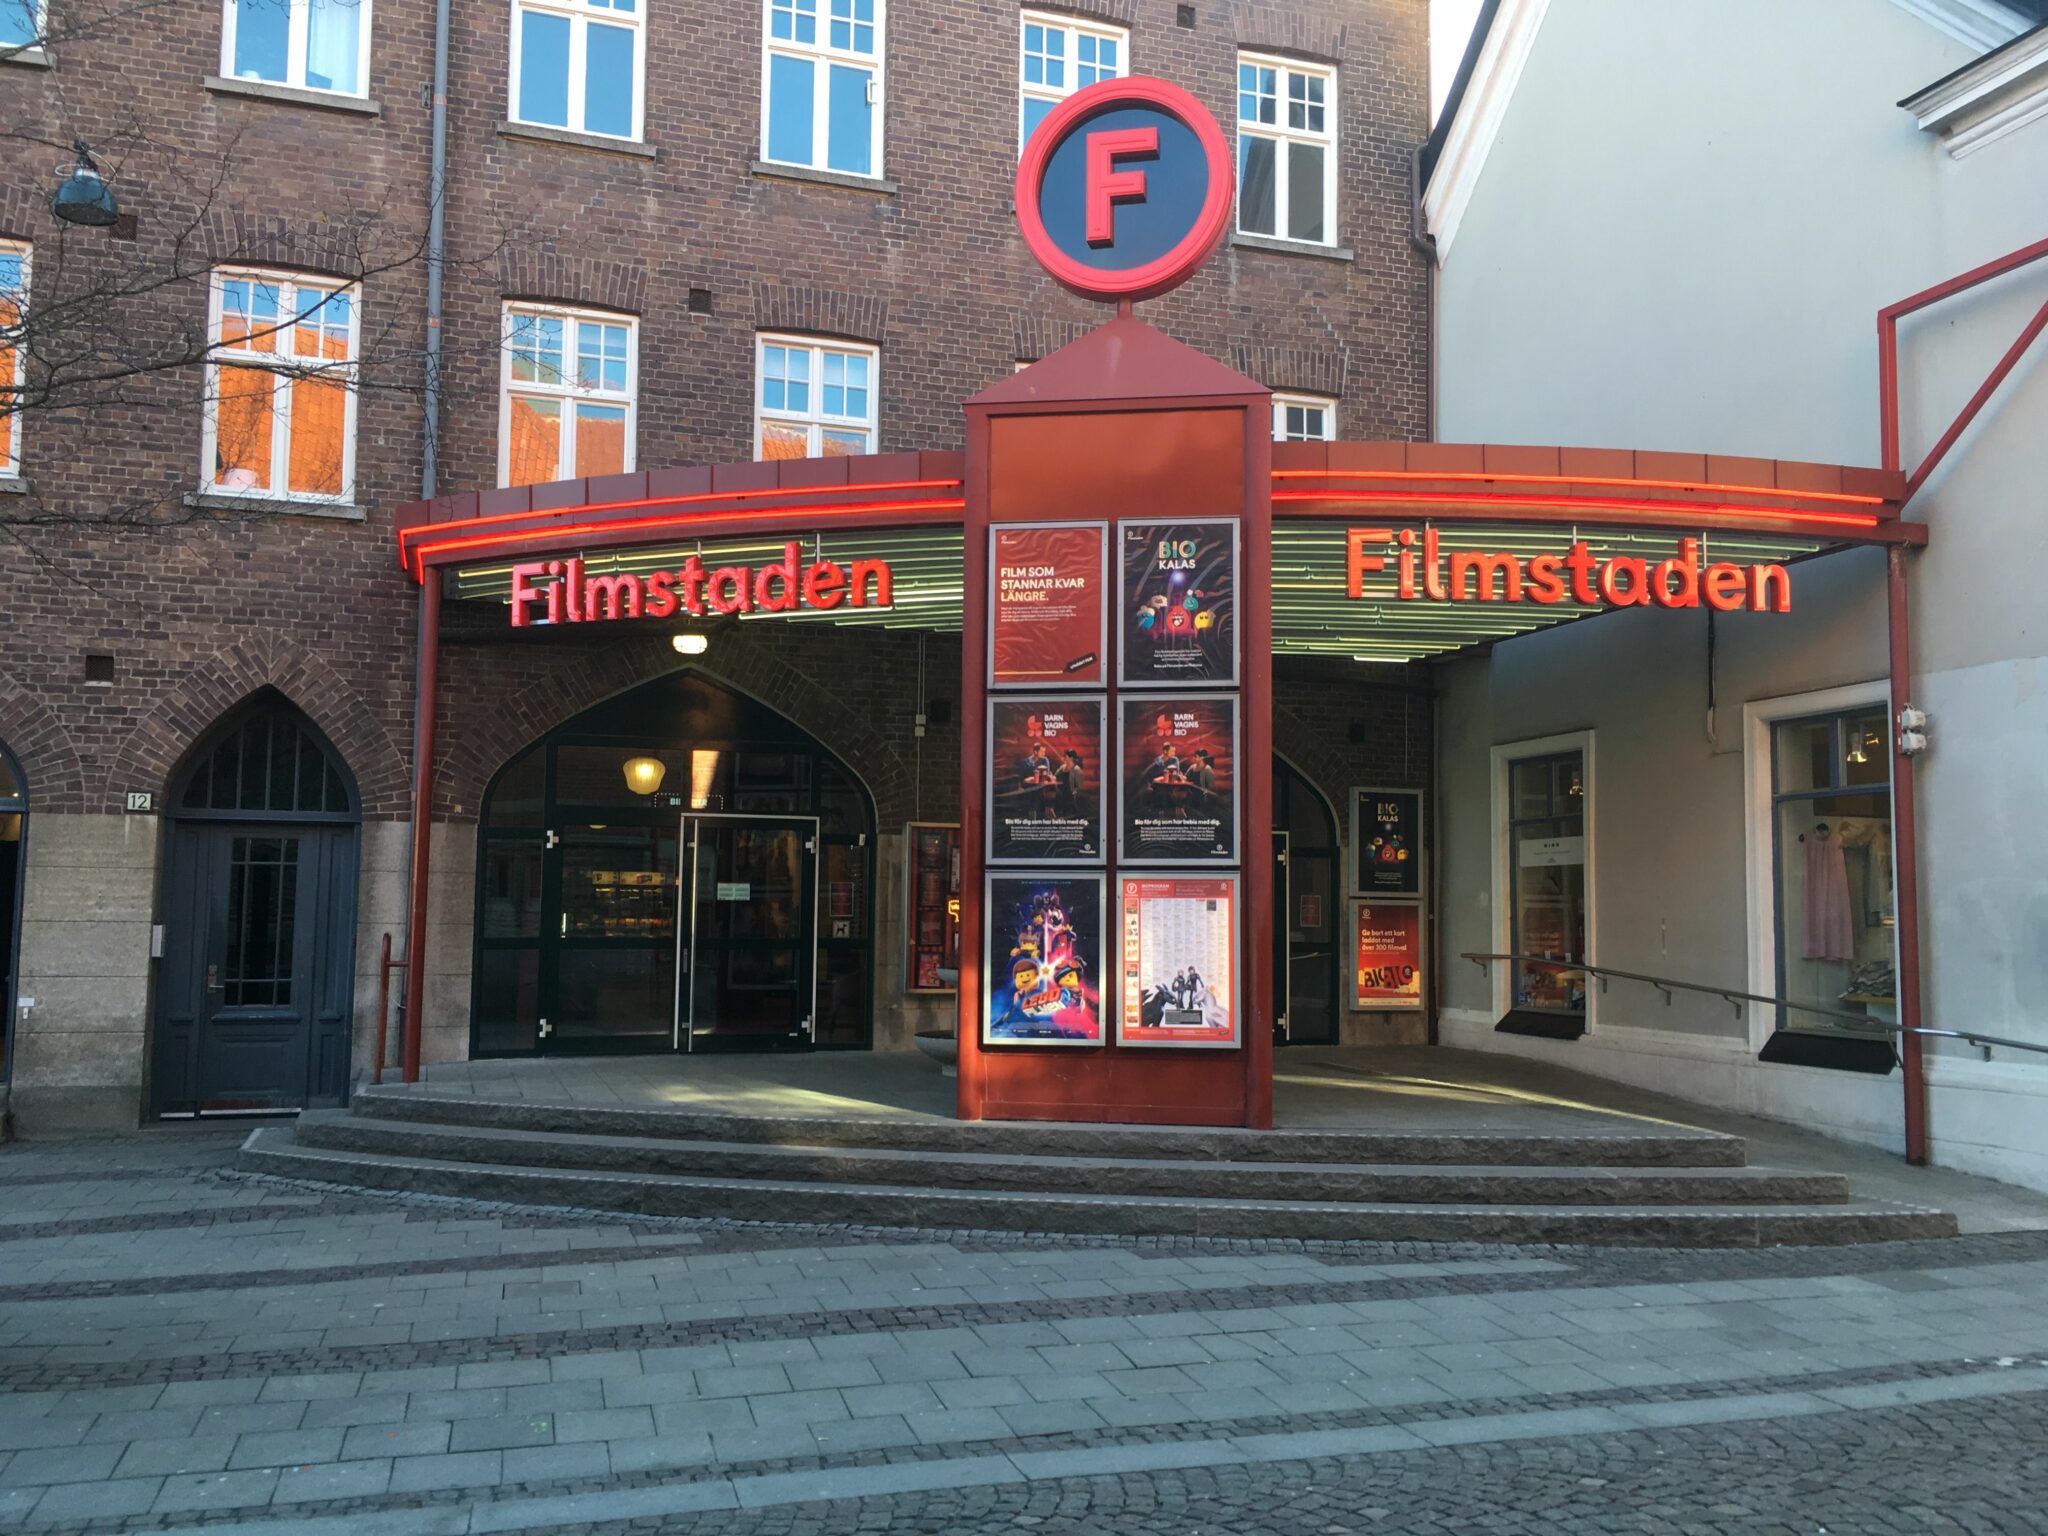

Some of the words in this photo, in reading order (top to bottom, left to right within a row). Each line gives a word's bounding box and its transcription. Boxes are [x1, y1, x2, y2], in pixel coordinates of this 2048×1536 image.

[1086, 127, 1159, 247] F
[1158, 540, 1197, 559] BIO
[1158, 559, 1196, 570] KALAS
[1346, 527, 1791, 613] Filmstaden
[1001, 567, 1026, 578] FILM
[1028, 566, 1054, 577] SOM
[511, 541, 894, 627] Filmstaden
[1001, 578, 1053, 590] STANNAR
[1055, 577, 1085, 588] KVAR
[1001, 589, 1049, 602] LÄNGRE.
[131, 794, 148, 809] 12
[1377, 802, 1399, 815] BIO
[1022, 818, 1031, 826] dig
[1152, 818, 1161, 826] dig
